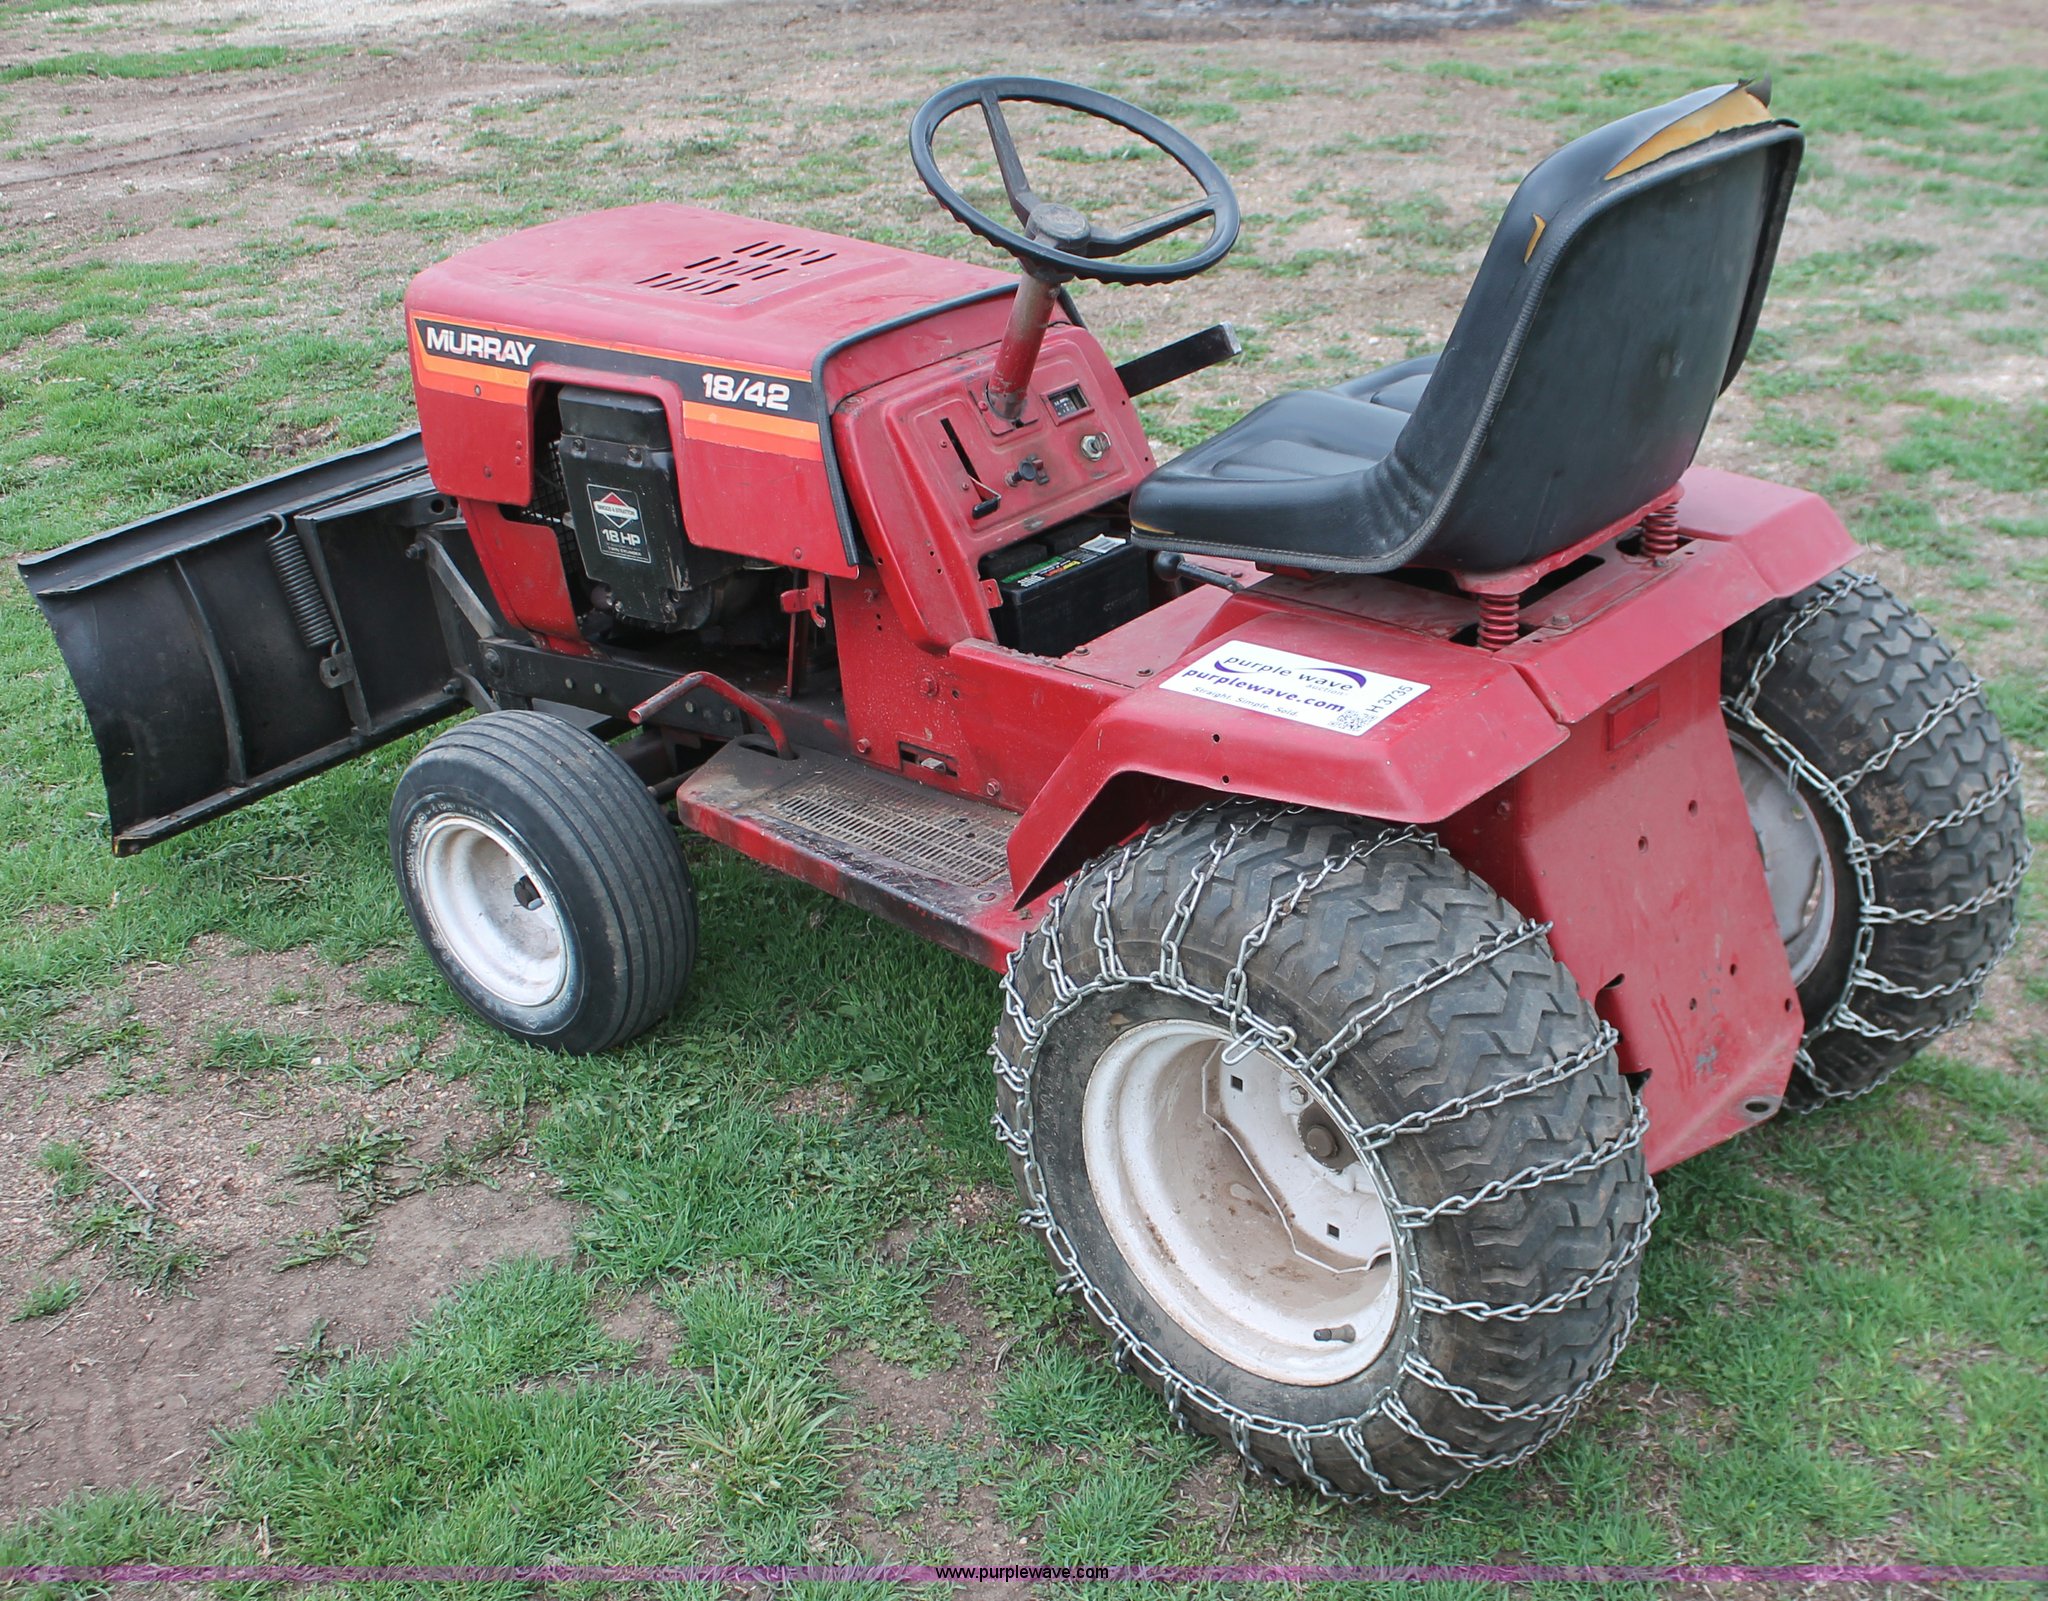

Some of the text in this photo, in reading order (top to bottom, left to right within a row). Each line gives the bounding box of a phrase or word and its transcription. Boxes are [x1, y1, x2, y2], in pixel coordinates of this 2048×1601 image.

[426, 327, 536, 366] MURRAY
[702, 372, 790, 411] 18/42
[602, 529, 641, 546] 18 HP
[1181, 669, 1345, 713] purplewave.com
[1223, 656, 1353, 691] purple wave
